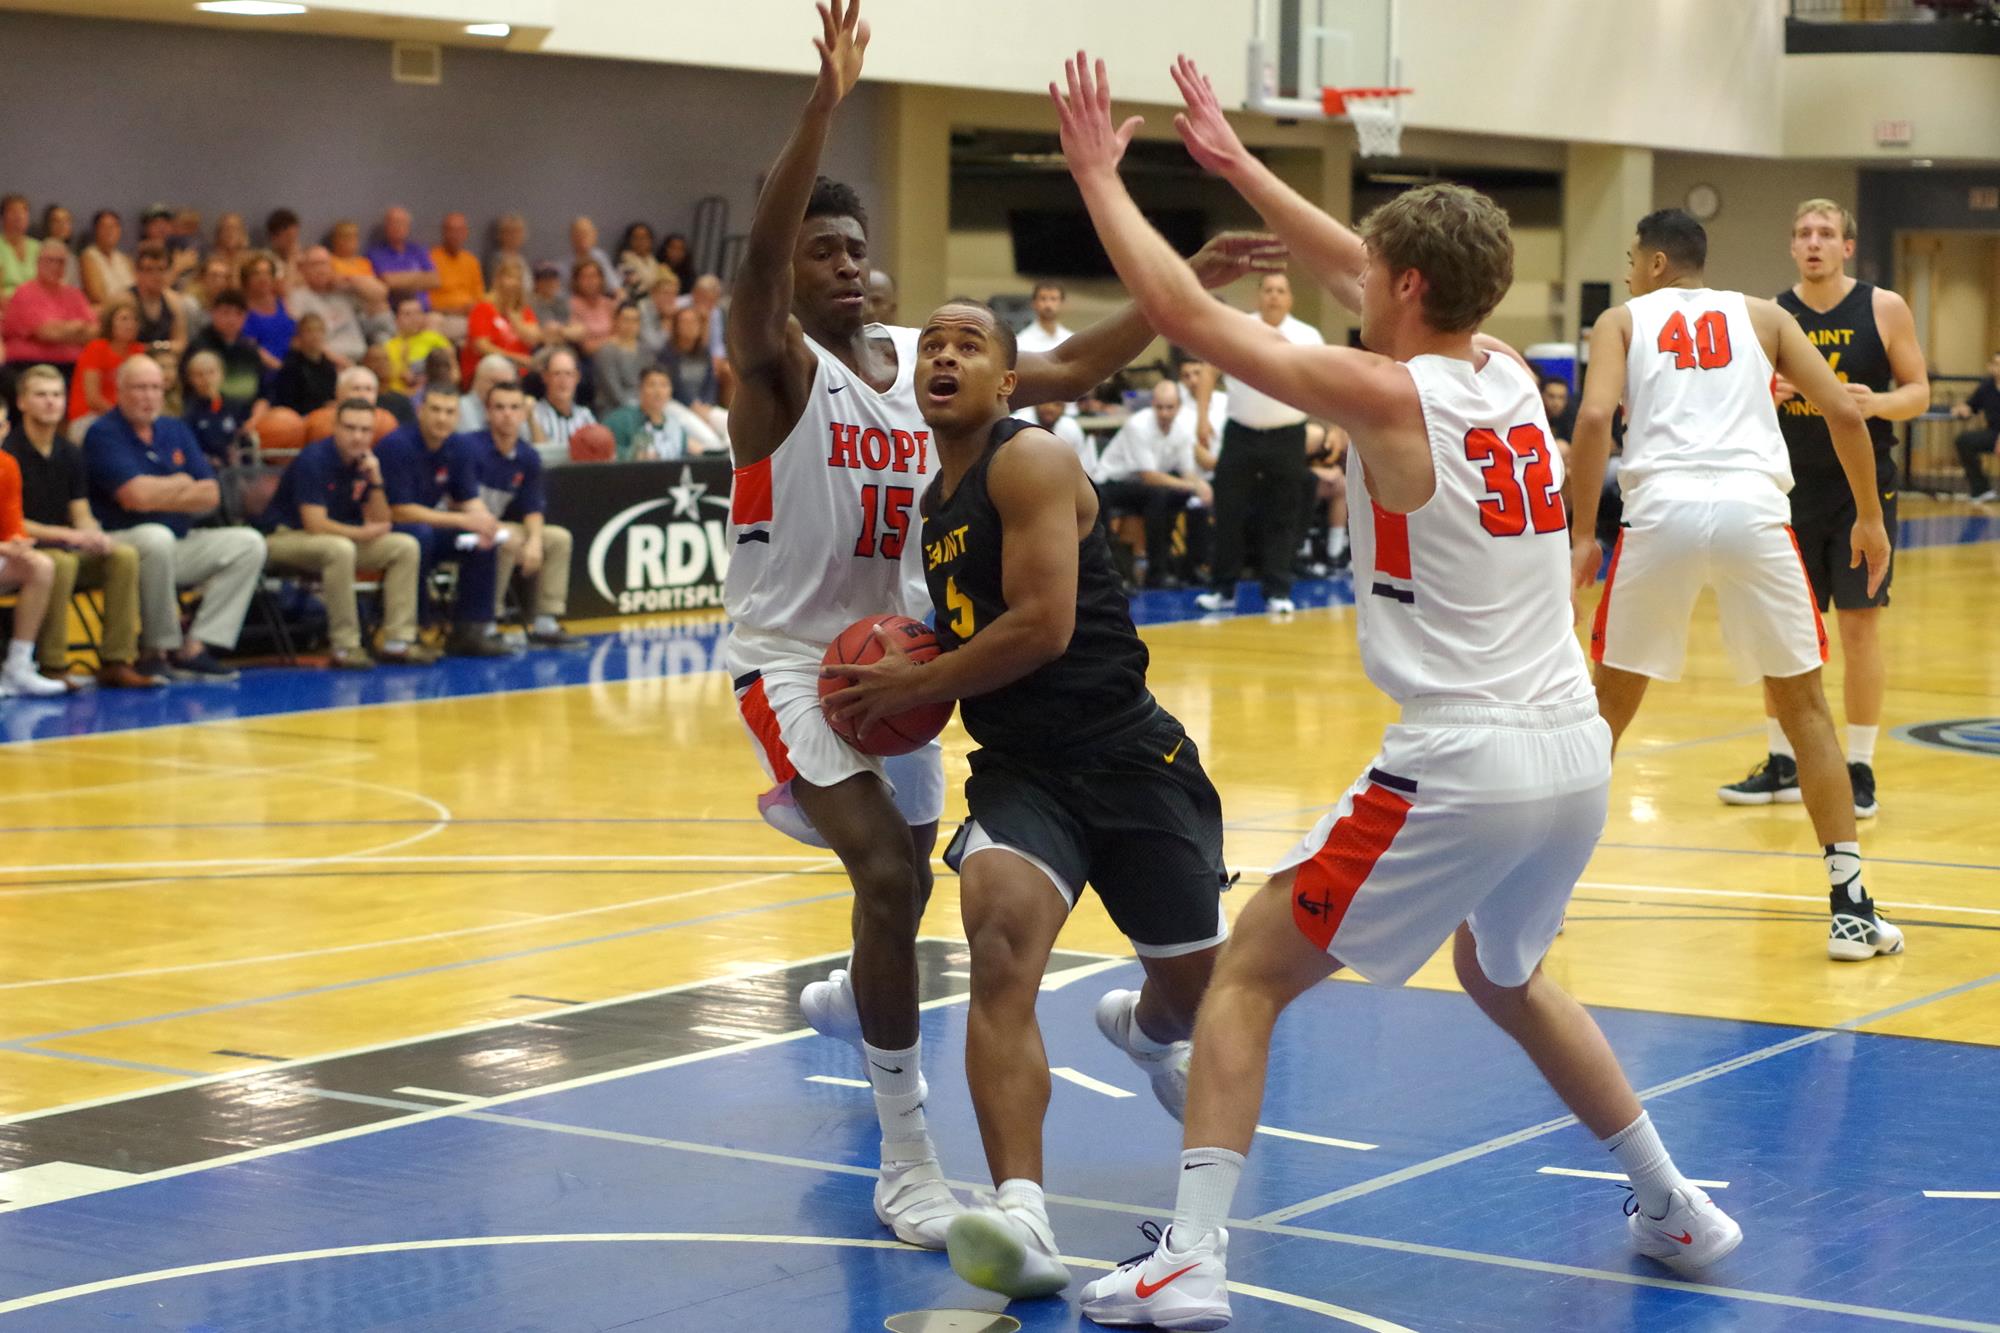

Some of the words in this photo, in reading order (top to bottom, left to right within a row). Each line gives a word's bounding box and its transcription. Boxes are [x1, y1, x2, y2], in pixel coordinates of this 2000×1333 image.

[1657, 310, 1732, 370] 40
[1808, 329, 1854, 346] AINT
[1464, 423, 1566, 537] 32
[854, 484, 914, 560] 15
[618, 584, 725, 614] SPORTSPL
[946, 576, 975, 638] 5
